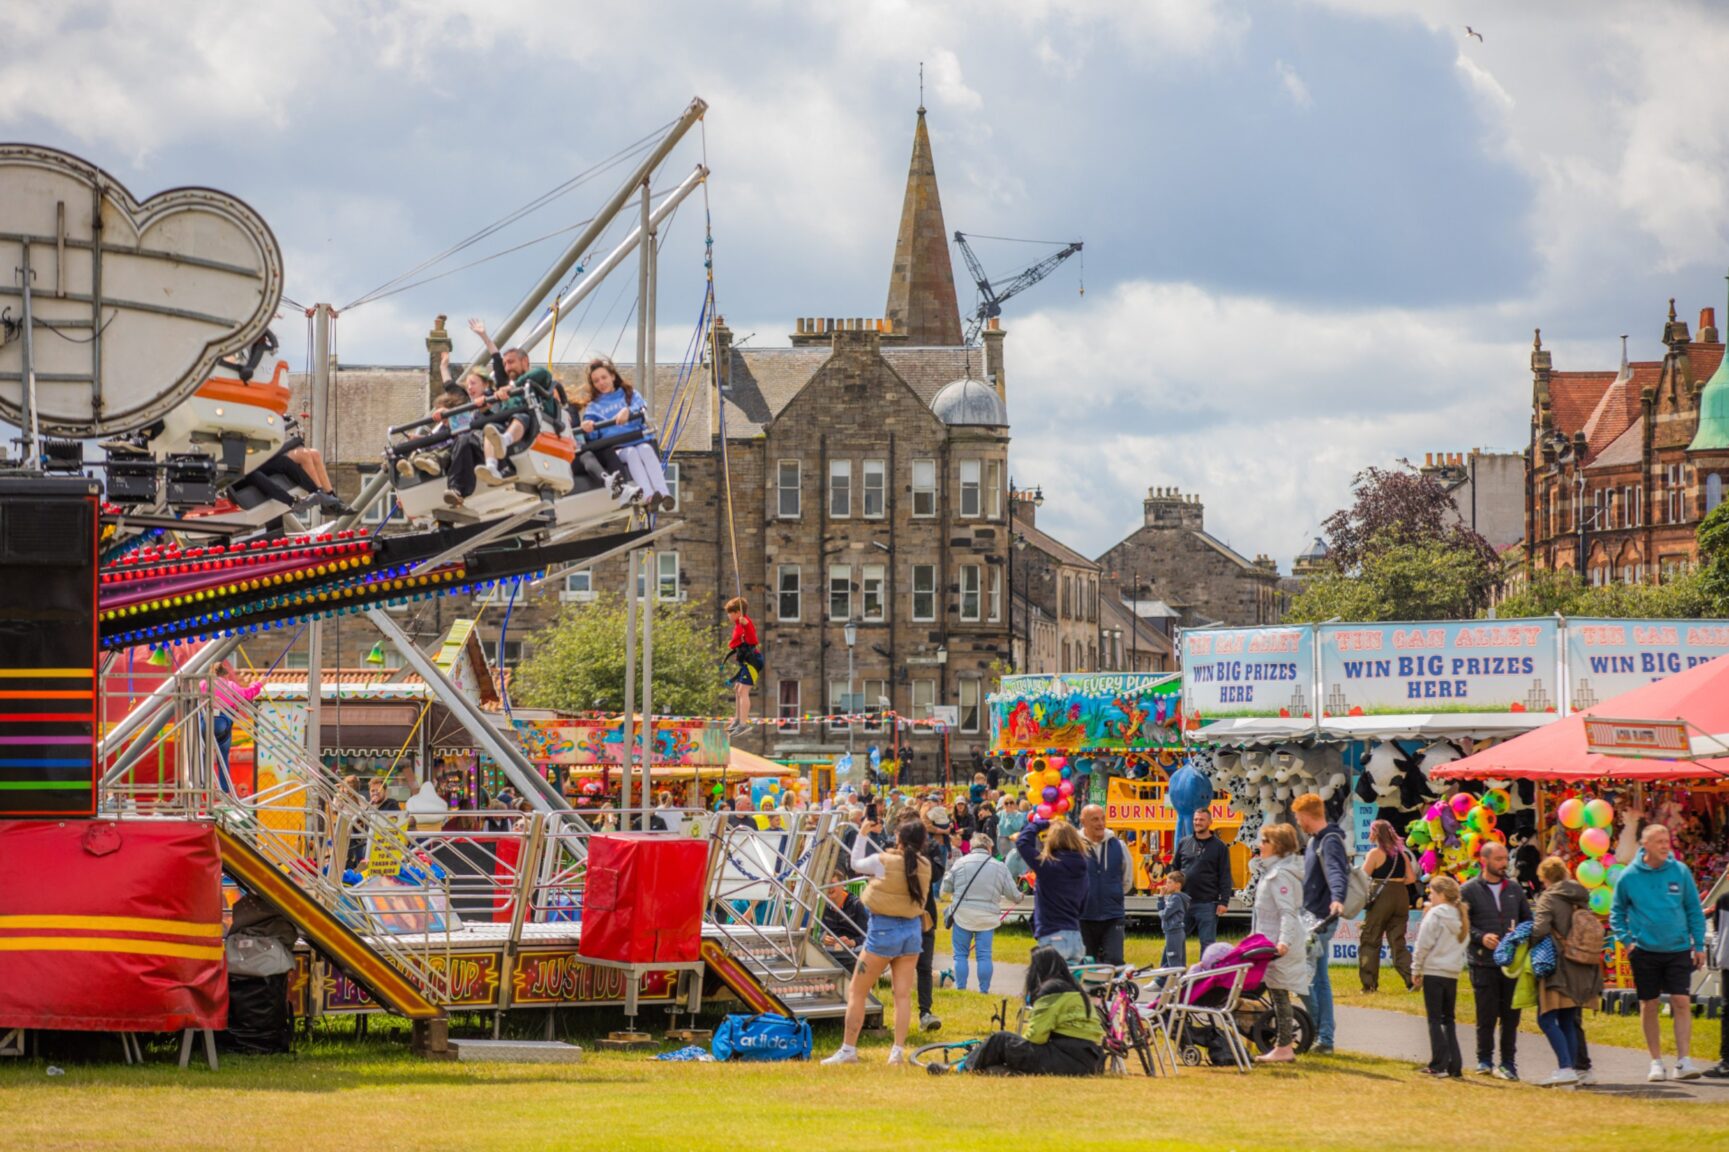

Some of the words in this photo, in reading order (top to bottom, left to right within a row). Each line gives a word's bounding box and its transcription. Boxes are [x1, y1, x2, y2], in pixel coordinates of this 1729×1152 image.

[1335, 631, 1383, 650] TIN
[1392, 629, 1445, 649] CAN
[1455, 626, 1541, 647] ALLEY
[1633, 626, 1679, 646] CAN
[1193, 665, 1214, 682] WIN
[1216, 661, 1241, 681] BIG
[1245, 663, 1297, 680] PRIZES
[1343, 660, 1391, 679] WIN
[1398, 655, 1444, 677] BIG
[1452, 657, 1534, 675] PRIZES
[1590, 655, 1635, 673] WIN
[1641, 652, 1681, 673] BIG
[1083, 676, 1123, 693] EVERY
[1219, 685, 1254, 703] HERE
[1407, 680, 1467, 698] HERE
[447, 960, 480, 999] UP
[740, 1033, 798, 1050] adidas
